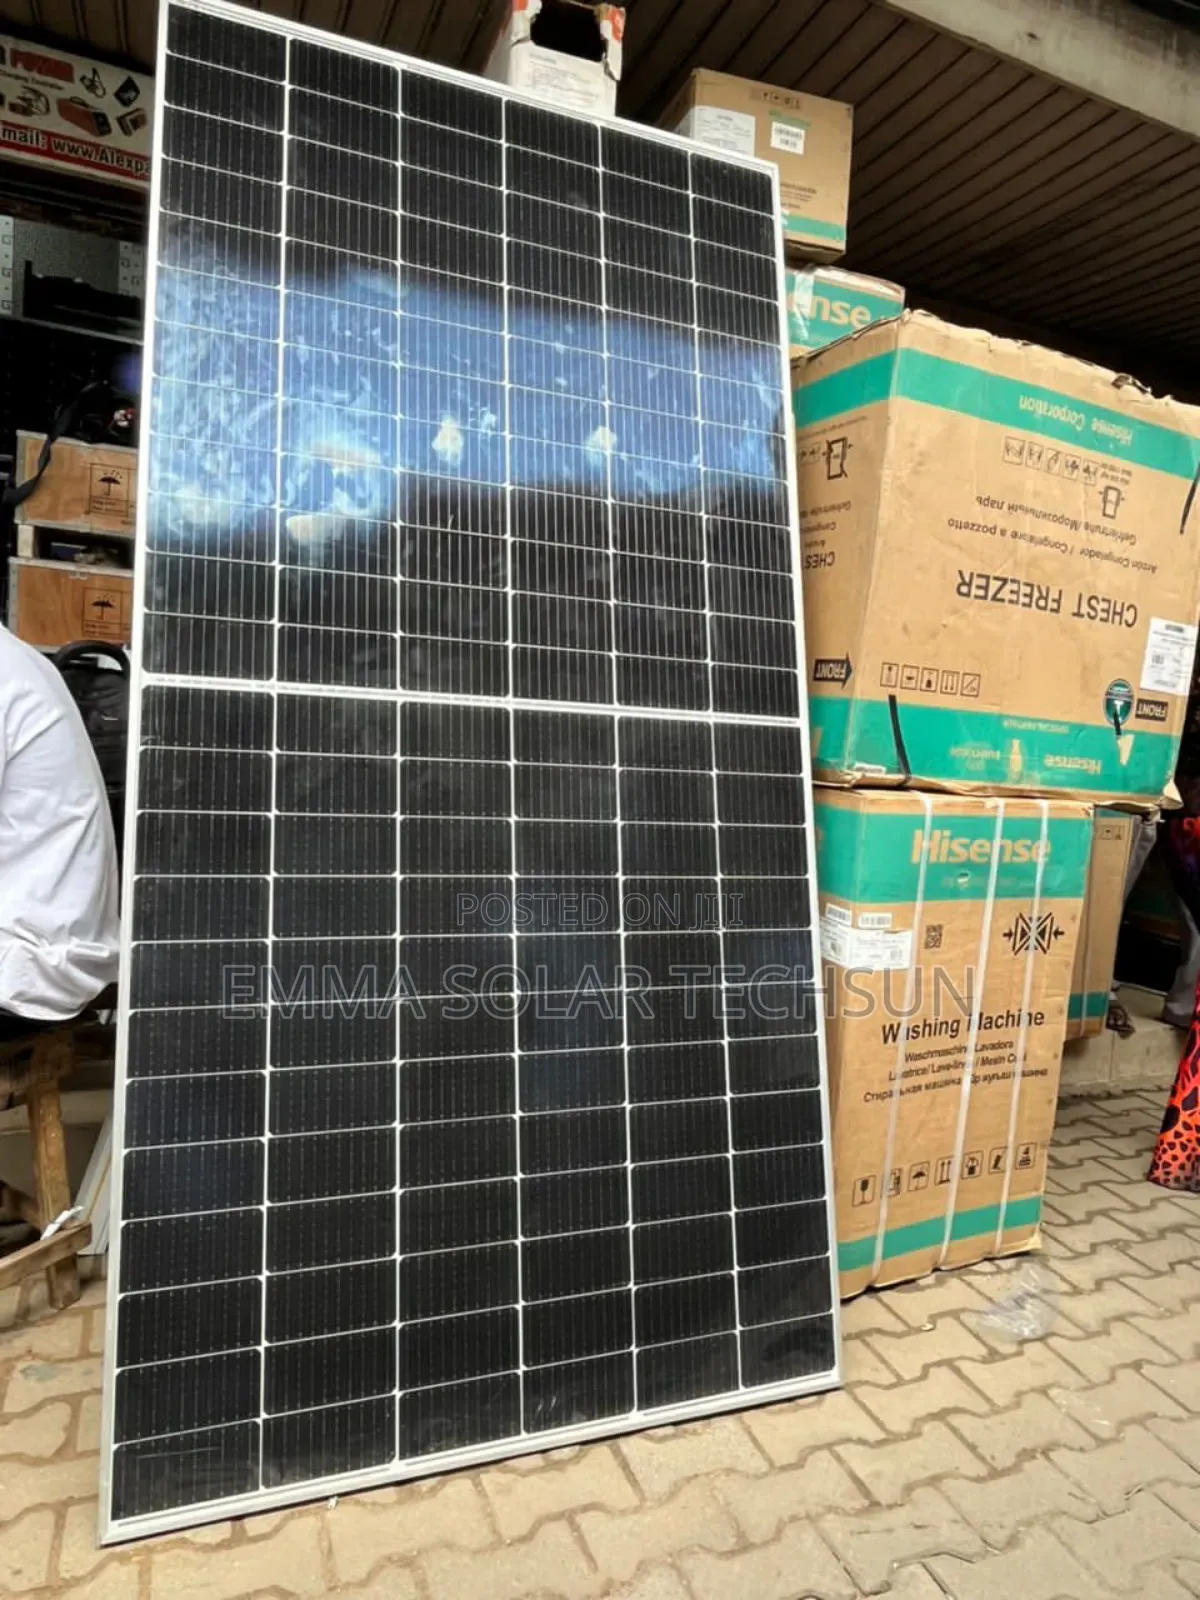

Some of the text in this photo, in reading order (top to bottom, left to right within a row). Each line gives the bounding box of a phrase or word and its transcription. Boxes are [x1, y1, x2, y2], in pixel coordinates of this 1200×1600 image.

[1019, 395, 1085, 430] Corporation
[948, 518, 997, 537] pozzetto
[956, 570, 1137, 628] CHEST FREEZER
[816, 662, 845, 678] FRONT
[1138, 703, 1166, 718] FRONT
[911, 830, 1050, 864] Hisense
[905, 1045, 969, 1063] Waschmaschin
[863, 1084, 922, 1102] Стираьная
